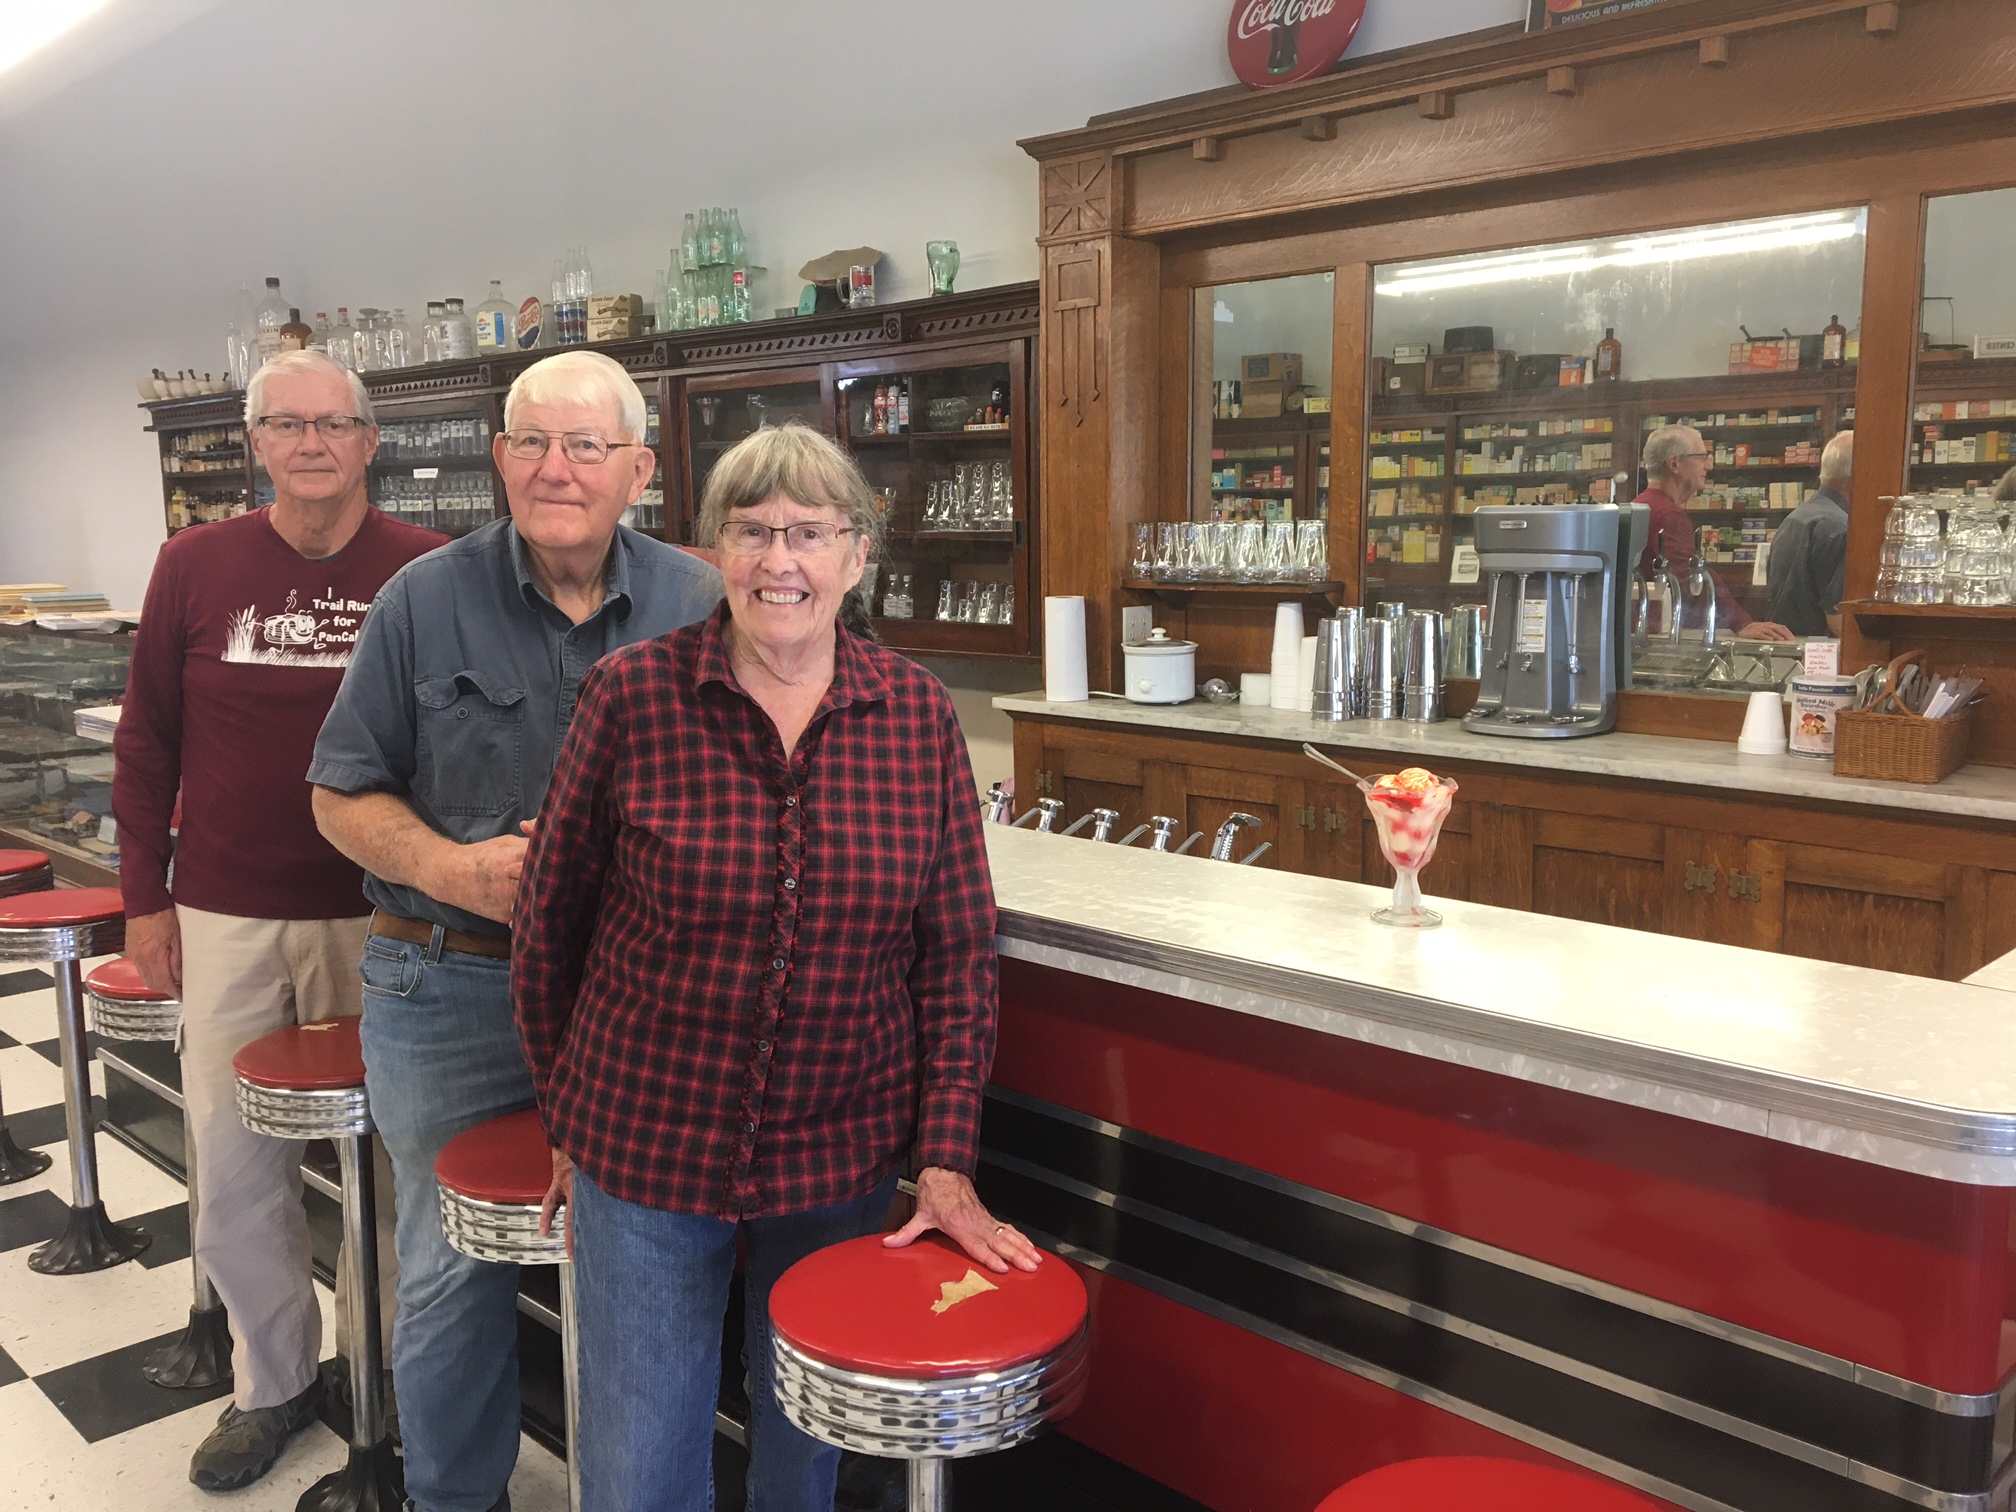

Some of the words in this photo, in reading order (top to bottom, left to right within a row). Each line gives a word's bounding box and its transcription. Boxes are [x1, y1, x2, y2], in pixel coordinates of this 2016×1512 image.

[1561, 9, 1601, 25] DELICIOUS
[1602, 4, 1620, 15] AND
[327, 586, 332, 600] I
[312, 598, 344, 612] Trail
[333, 615, 357, 627] for
[1819, 698, 1836, 708] Milk
